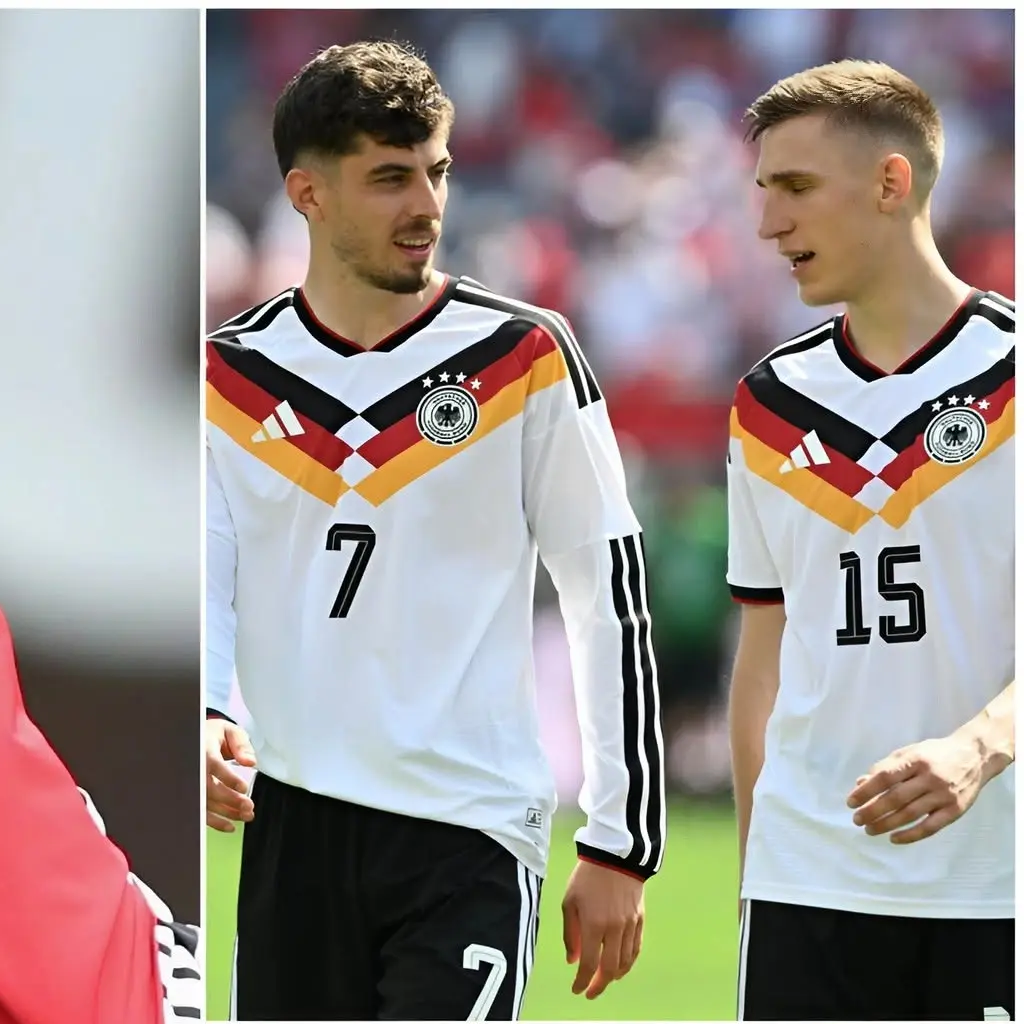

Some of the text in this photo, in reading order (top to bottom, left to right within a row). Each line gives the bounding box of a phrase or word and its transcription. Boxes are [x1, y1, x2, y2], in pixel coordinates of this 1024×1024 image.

[325, 523, 376, 618] 7
[836, 545, 926, 646] 15
[463, 943, 507, 1021] 7
